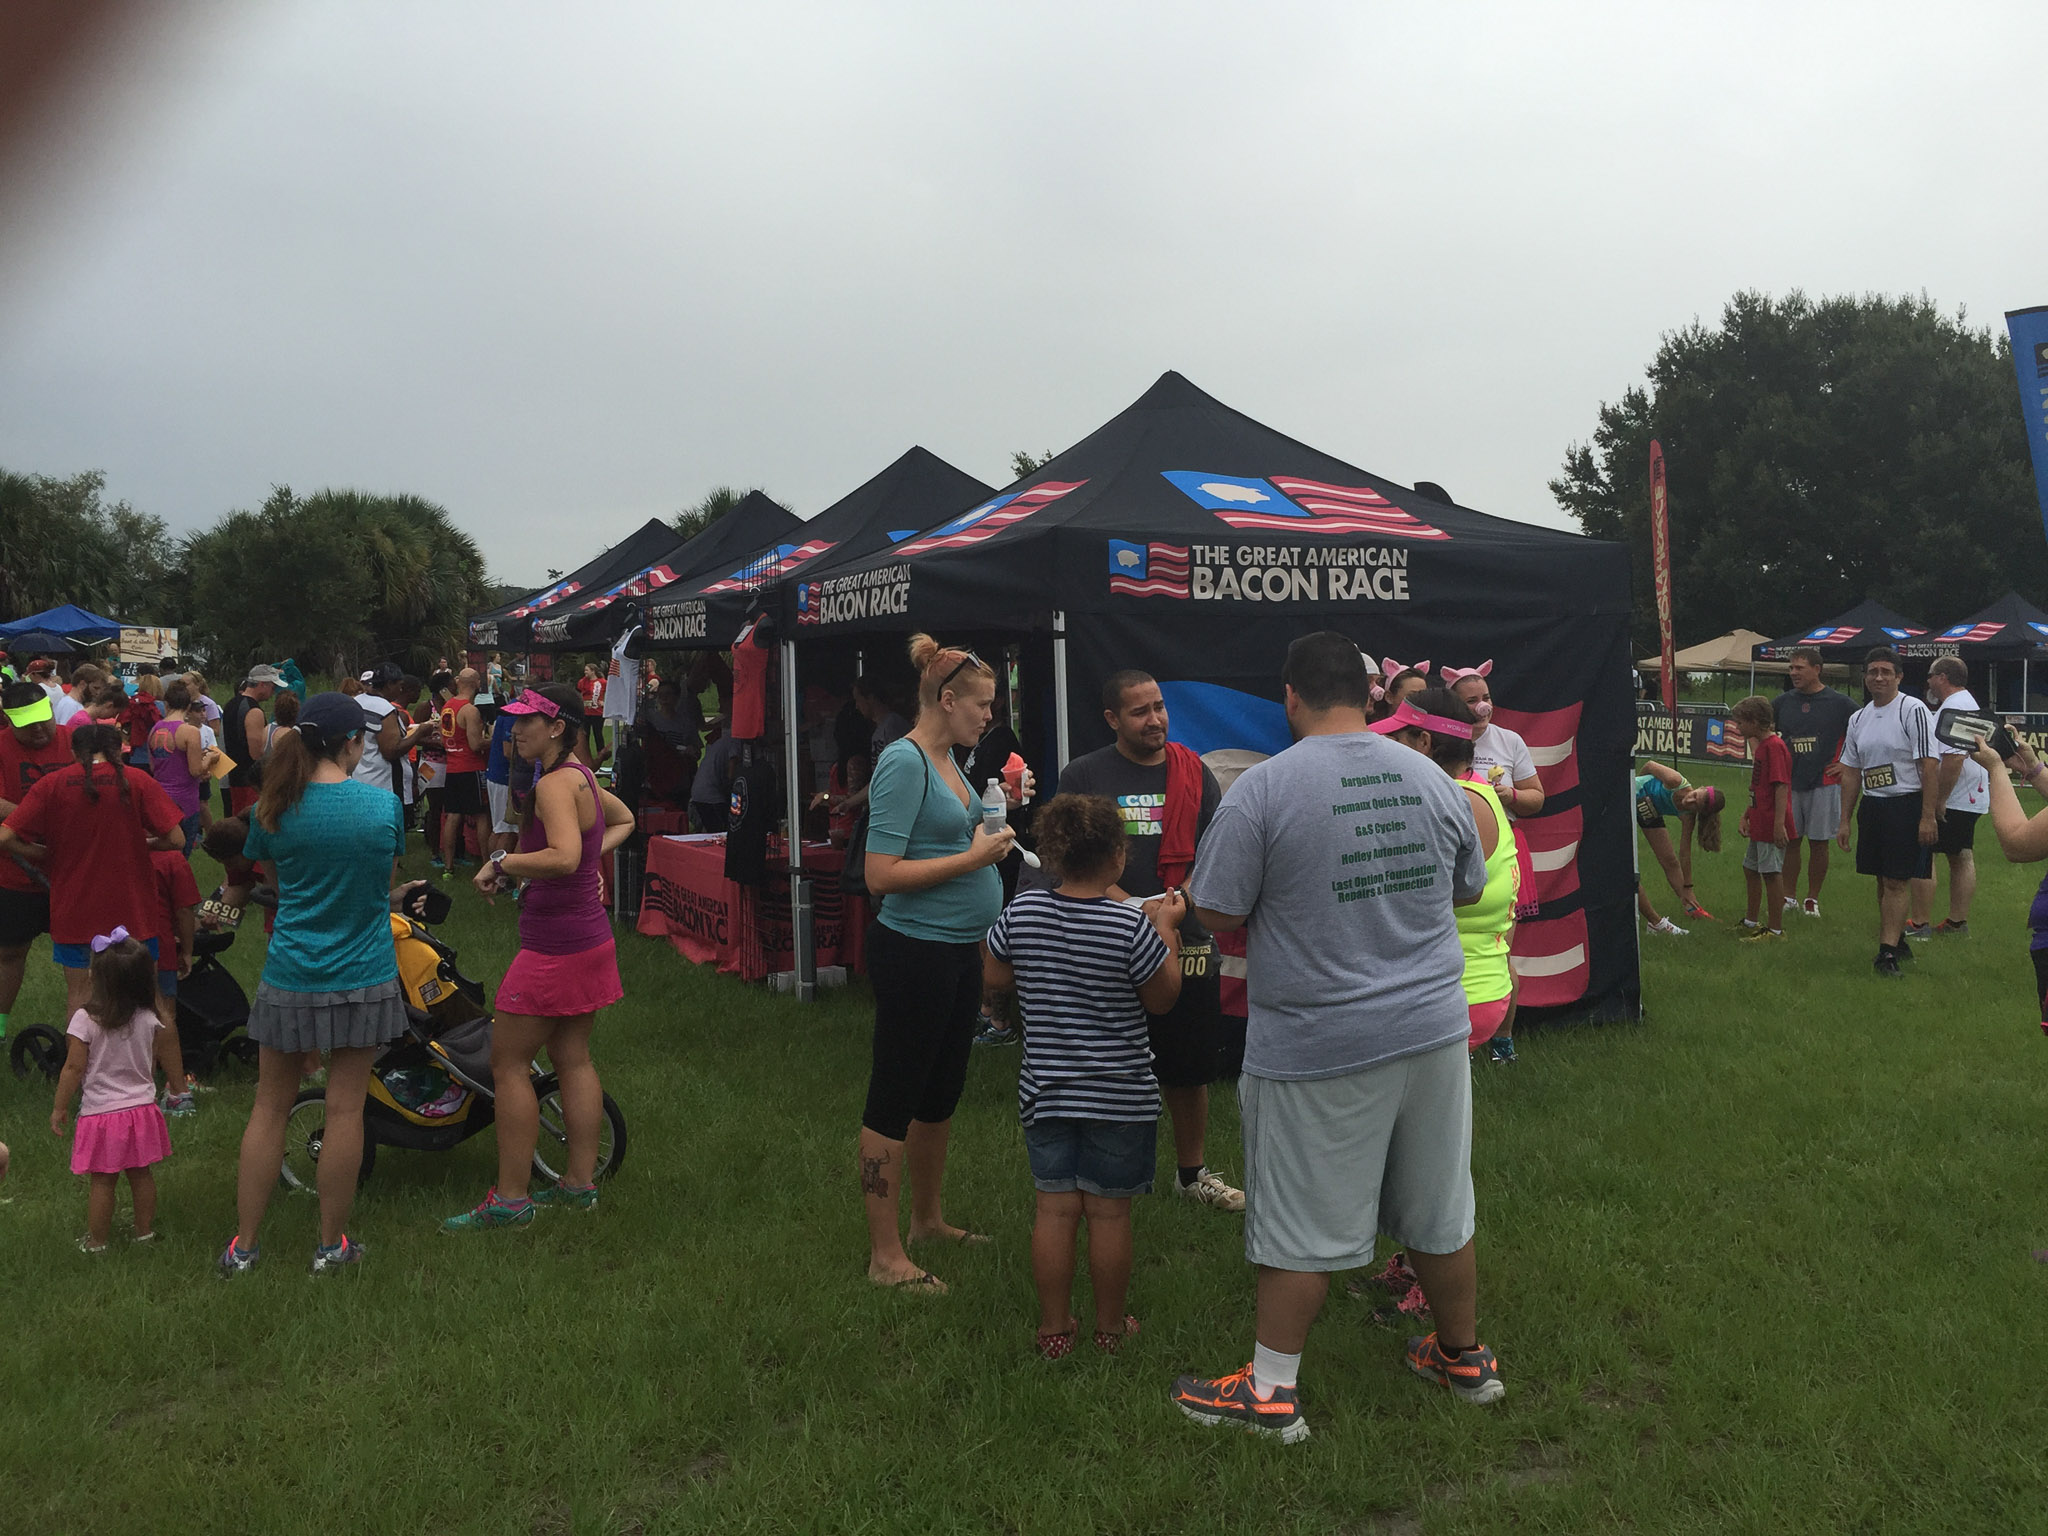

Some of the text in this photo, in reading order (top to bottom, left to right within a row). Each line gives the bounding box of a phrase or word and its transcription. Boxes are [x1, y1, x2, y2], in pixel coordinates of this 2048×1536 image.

[1192, 545, 1408, 567] THE GREAT AMERICAN
[822, 564, 911, 595] THE GREAT AMERICAN
[1192, 567, 1410, 601] BACON RACE
[661, 604, 677, 617] GREAT
[677, 600, 706, 615] AMERICAN
[820, 582, 911, 625] BACON RACE
[654, 614, 706, 640] BACON RACE
[1907, 648, 1960, 657] BACON RACE
[1656, 731, 1691, 754] RACE
[1793, 742, 1812, 753] 1011
[1341, 772, 1403, 787] Bargains Plus
[1866, 773, 1893, 788] 0295
[1125, 794, 1166, 807] COL
[1332, 795, 1422, 816] Fremaux Quick Stop
[1125, 808, 1151, 820] ME
[1138, 821, 1163, 835] RA
[1355, 821, 1407, 837] G&S Cycles
[1341, 842, 1426, 865] Holley Automotive
[1332, 864, 1438, 891] Last Option Foundation
[1338, 876, 1435, 903] Repairs & Inspection
[202, 900, 240, 920] 0538
